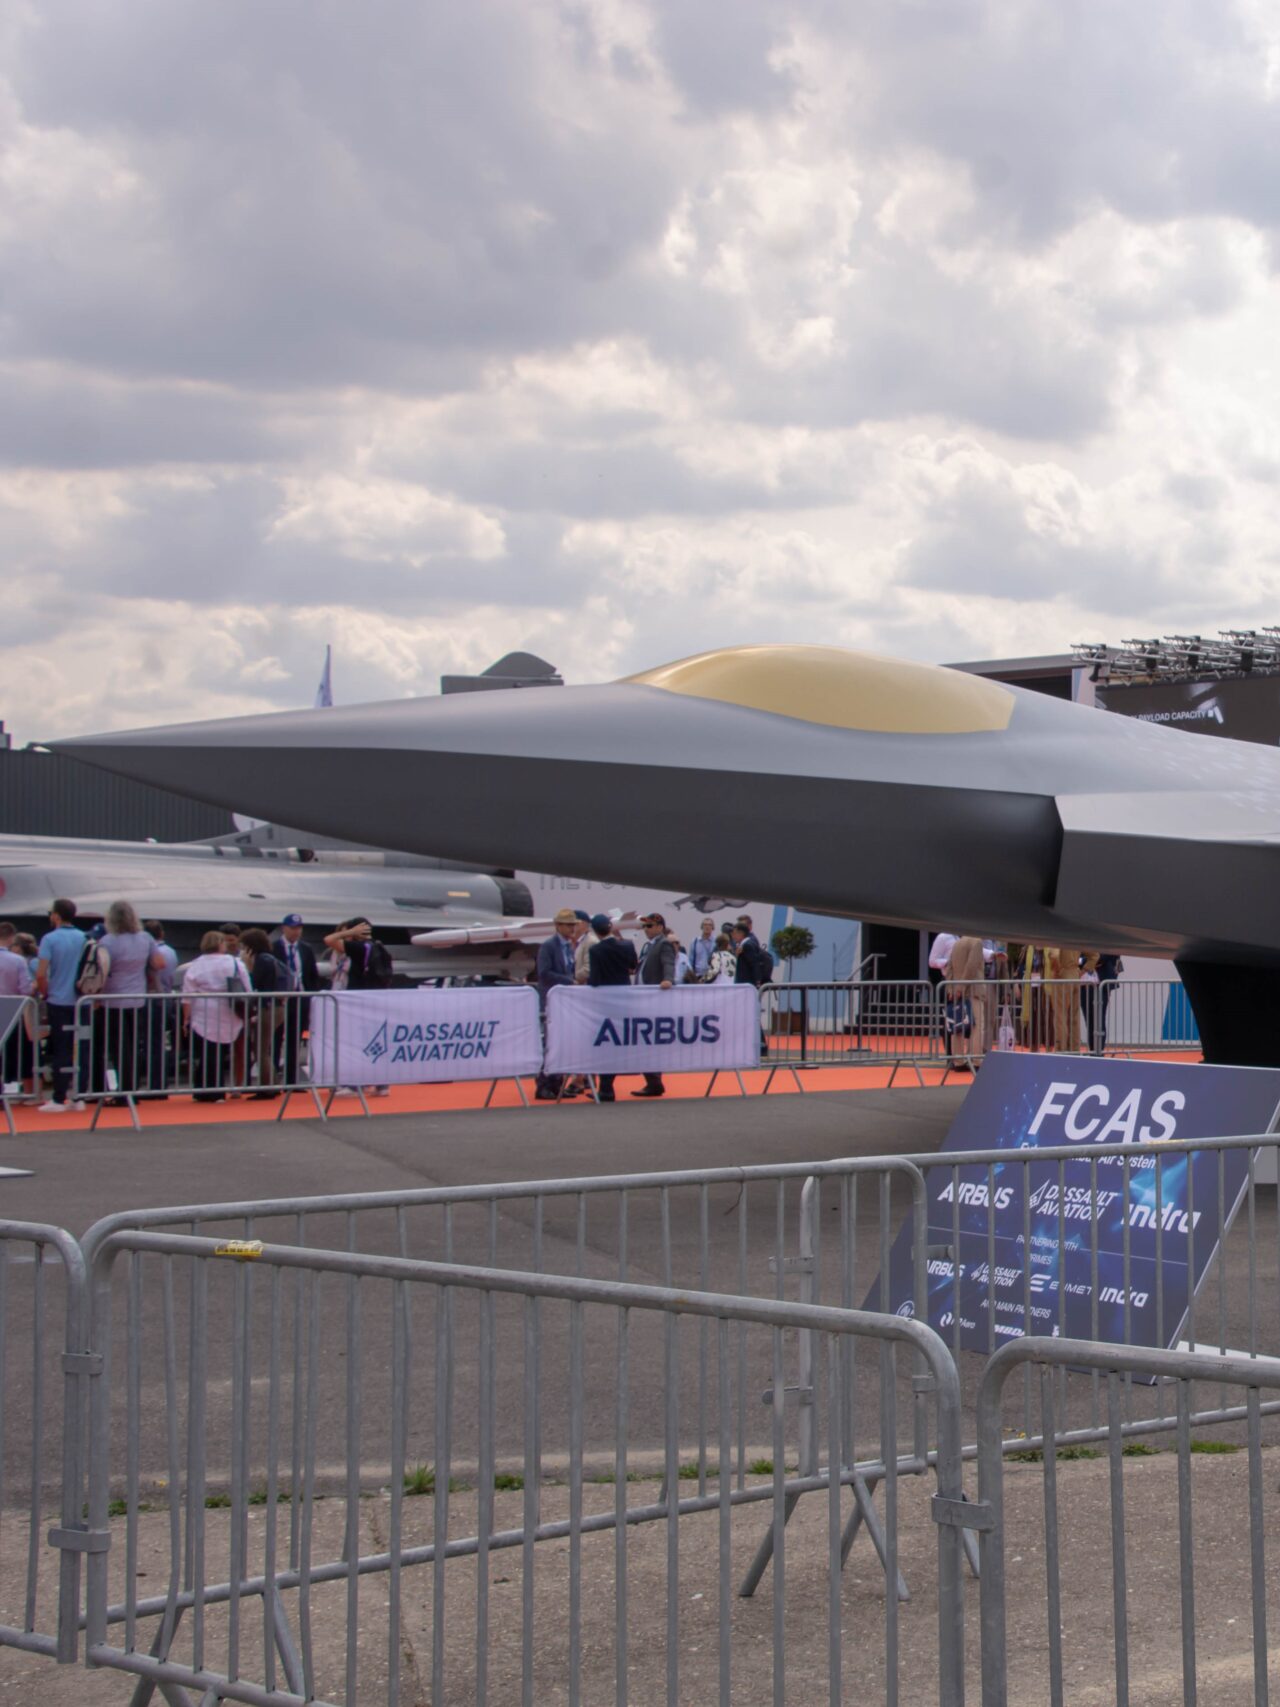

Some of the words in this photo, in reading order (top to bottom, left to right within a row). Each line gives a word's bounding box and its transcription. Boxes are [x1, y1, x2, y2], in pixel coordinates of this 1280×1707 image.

[1171, 709, 1206, 720] CAPACITY
[392, 1020, 500, 1042] DASSAULT
[593, 1015, 720, 1046] AIRBUS
[391, 1041, 491, 1062] AVIATION
[1028, 1082, 1186, 1144] FCAS
[1016, 1234, 1059, 1249] PATNERING
[1030, 1253, 1053, 1265] RIMES
[1014, 1304, 1052, 1319] PATNERS
